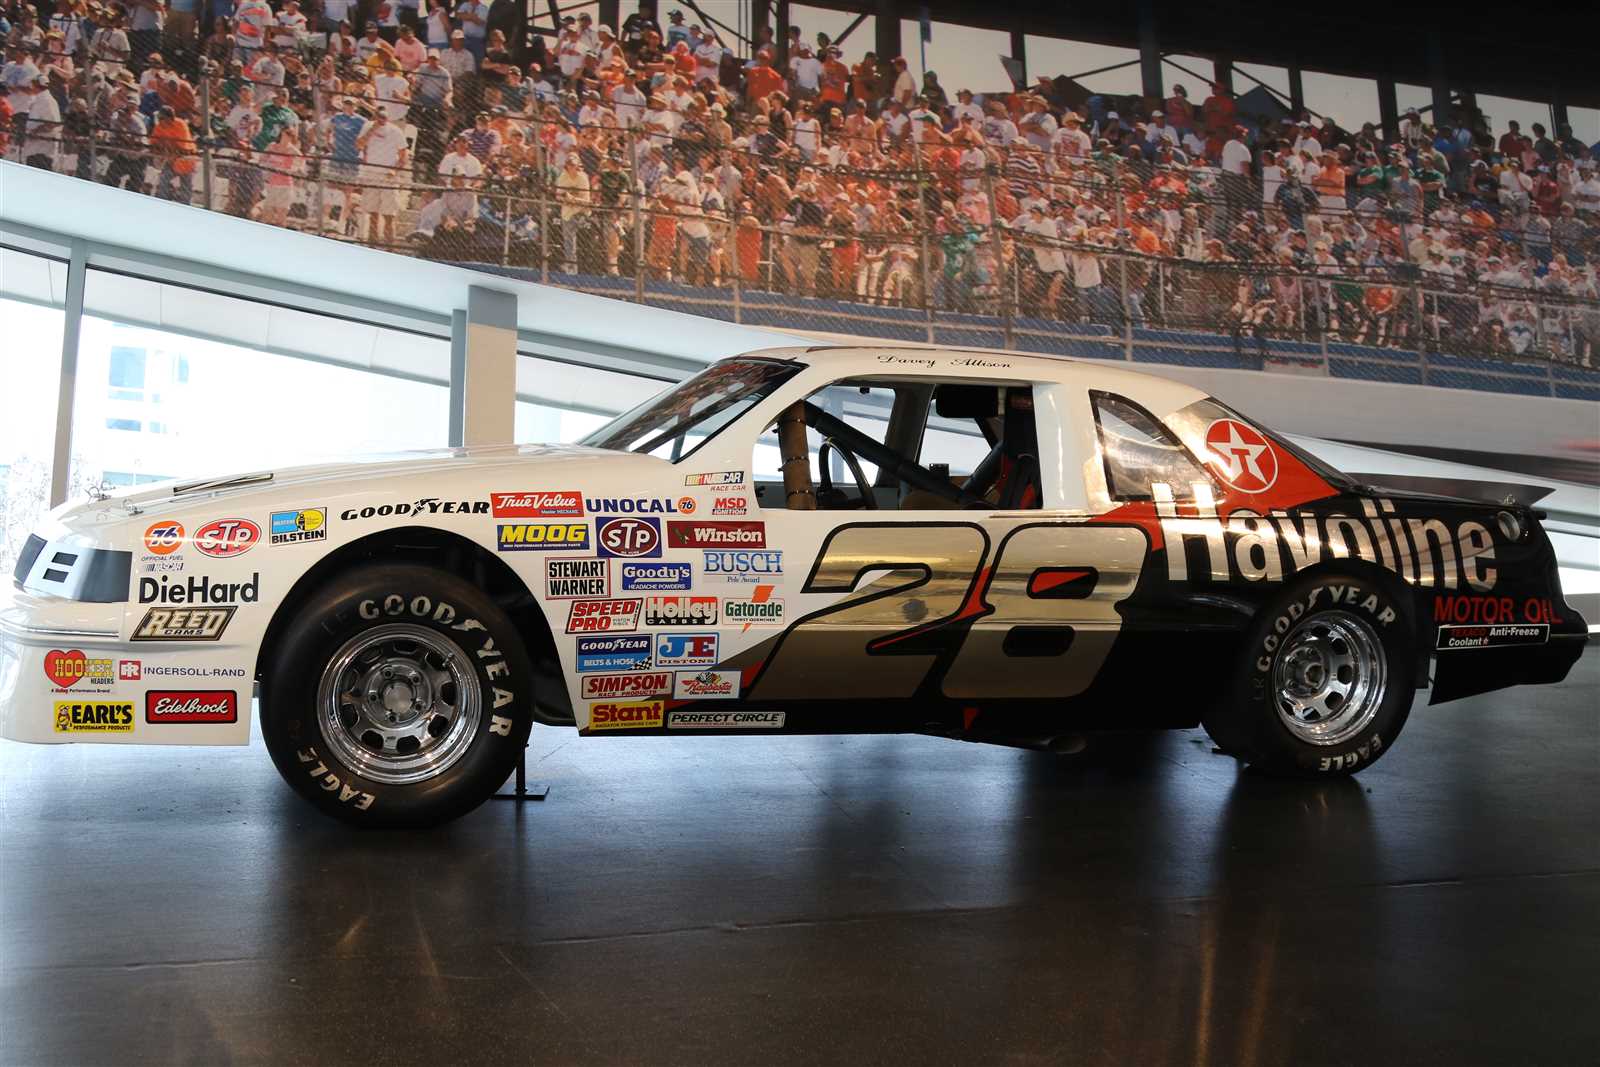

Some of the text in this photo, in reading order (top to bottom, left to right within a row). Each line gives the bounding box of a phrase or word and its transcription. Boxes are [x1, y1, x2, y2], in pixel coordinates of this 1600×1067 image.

[877, 354, 1012, 368] Davey Allison
[585, 498, 693, 513] UNOCAL 76
[714, 497, 747, 509] MSD
[149, 526, 181, 547] 76
[201, 522, 252, 549] STP
[271, 529, 325, 544] BILSTEIN
[500, 525, 587, 542] MOOG
[607, 522, 651, 549] STP
[693, 528, 763, 542] Winston
[1151, 480, 1500, 592] Havoline
[549, 561, 605, 577] STEWART
[704, 552, 783, 573] BUSCH
[623, 566, 690, 582] Goody's
[139, 572, 259, 603] DieHard
[549, 579, 604, 595] WARNER
[573, 601, 637, 617] SPEED
[646, 597, 717, 624] Holley
[725, 601, 783, 617] Gatorade
[748, 521, 1152, 700] 28
[1433, 595, 1563, 624] MOTOR OIL
[139, 610, 227, 636] REED
[569, 616, 611, 631] PRO
[1451, 627, 1540, 637] TEXACO Anti-Freeze
[659, 636, 716, 657] JE
[1448, 638, 1482, 647] Coolant
[144, 667, 246, 677] INGERSOLL-RAND
[587, 675, 667, 693] SIMPSON
[154, 697, 229, 713] Edelbrock
[592, 702, 662, 723] Stant
[72, 704, 133, 724] EARL'S
[671, 713, 780, 722] PERFECT CIRCLE
[1319, 733, 1383, 771] EAGLE
[297, 747, 376, 810] EAGLE
